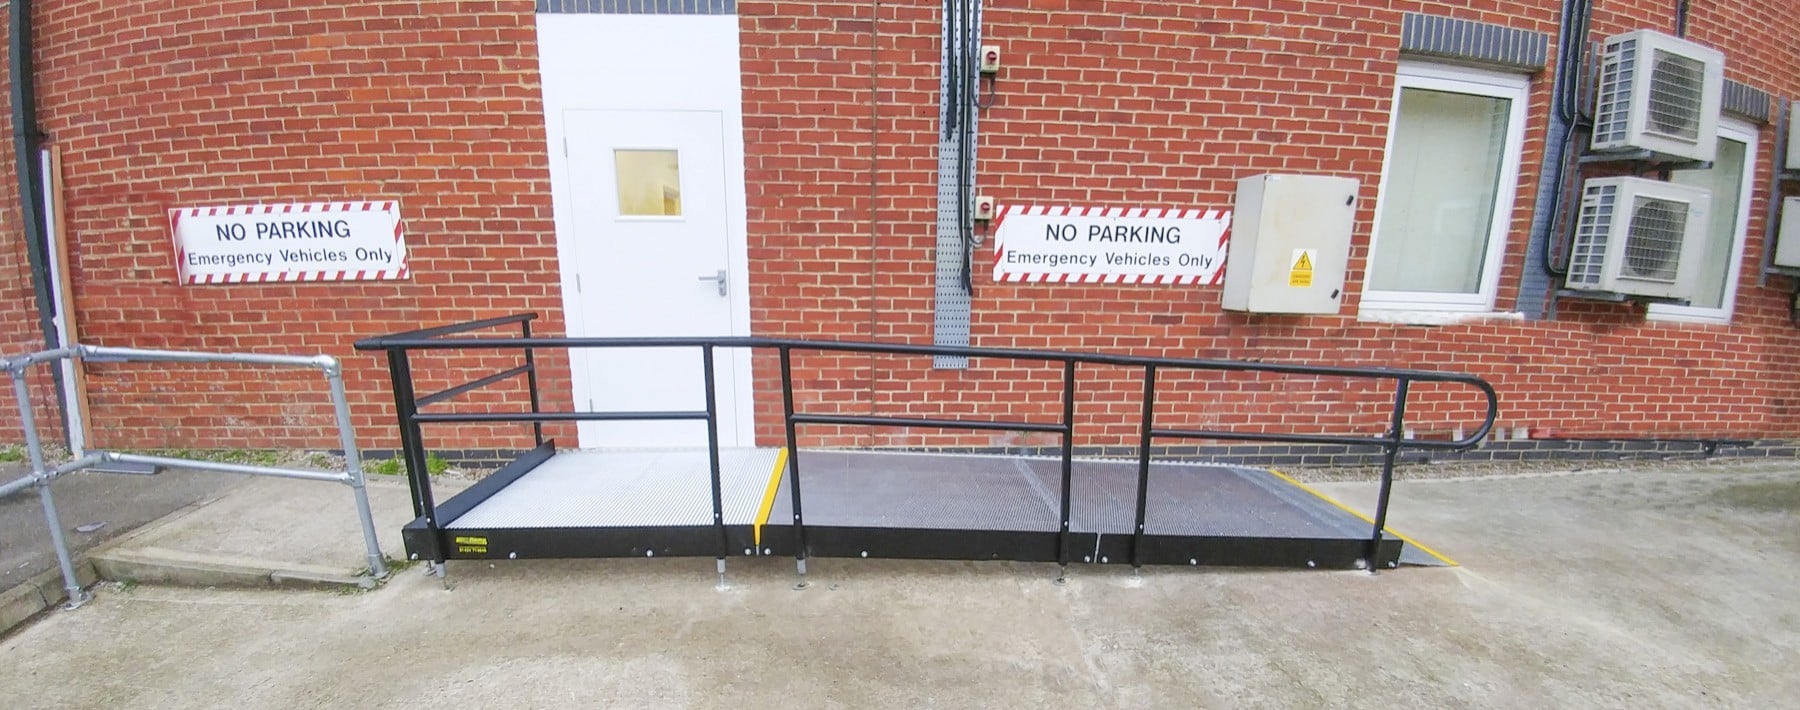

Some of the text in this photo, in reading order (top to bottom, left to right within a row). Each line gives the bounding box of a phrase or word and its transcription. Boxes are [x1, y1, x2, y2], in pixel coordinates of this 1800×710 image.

[215, 219, 351, 242] NO PARKING
[1045, 223, 1181, 244] NO PARKING
[188, 247, 392, 267] Emergency Vehicles Only
[1007, 250, 1213, 269] Emergency Vehicles Only
